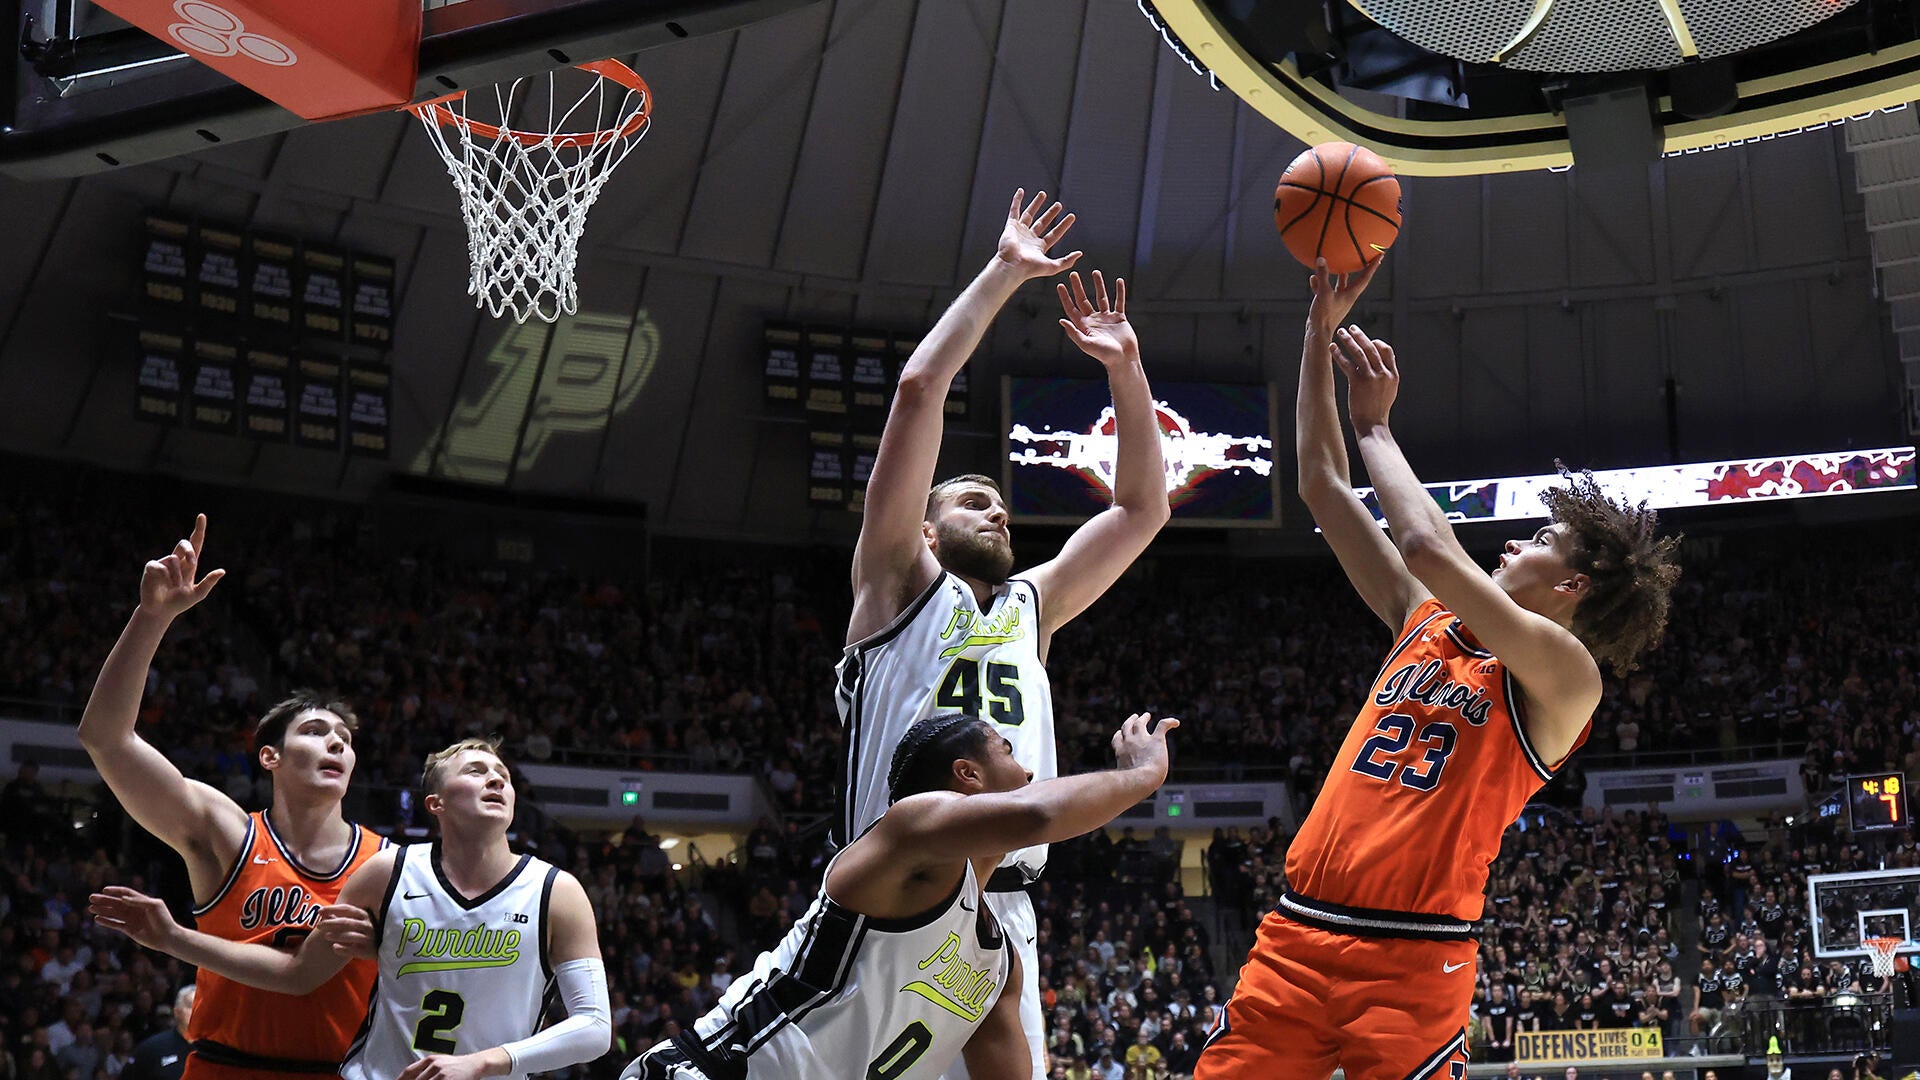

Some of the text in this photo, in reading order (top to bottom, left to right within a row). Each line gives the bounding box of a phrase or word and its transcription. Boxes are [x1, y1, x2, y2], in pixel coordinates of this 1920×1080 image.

[935, 656, 1025, 727] 45
[1350, 713, 1459, 792] 23
[1862, 777, 1900, 795] 4:18
[1879, 794, 1898, 821] 7
[239, 885, 323, 931] Illin
[396, 918, 521, 966] Purdue
[917, 930, 996, 1016] Purdu
[411, 988, 466, 1056] 2
[1600, 1031, 1628, 1045] LIVES
[865, 1019, 935, 1080] 0
[1518, 1032, 1598, 1060] DEFENSE
[1600, 1045, 1628, 1057] HERE
